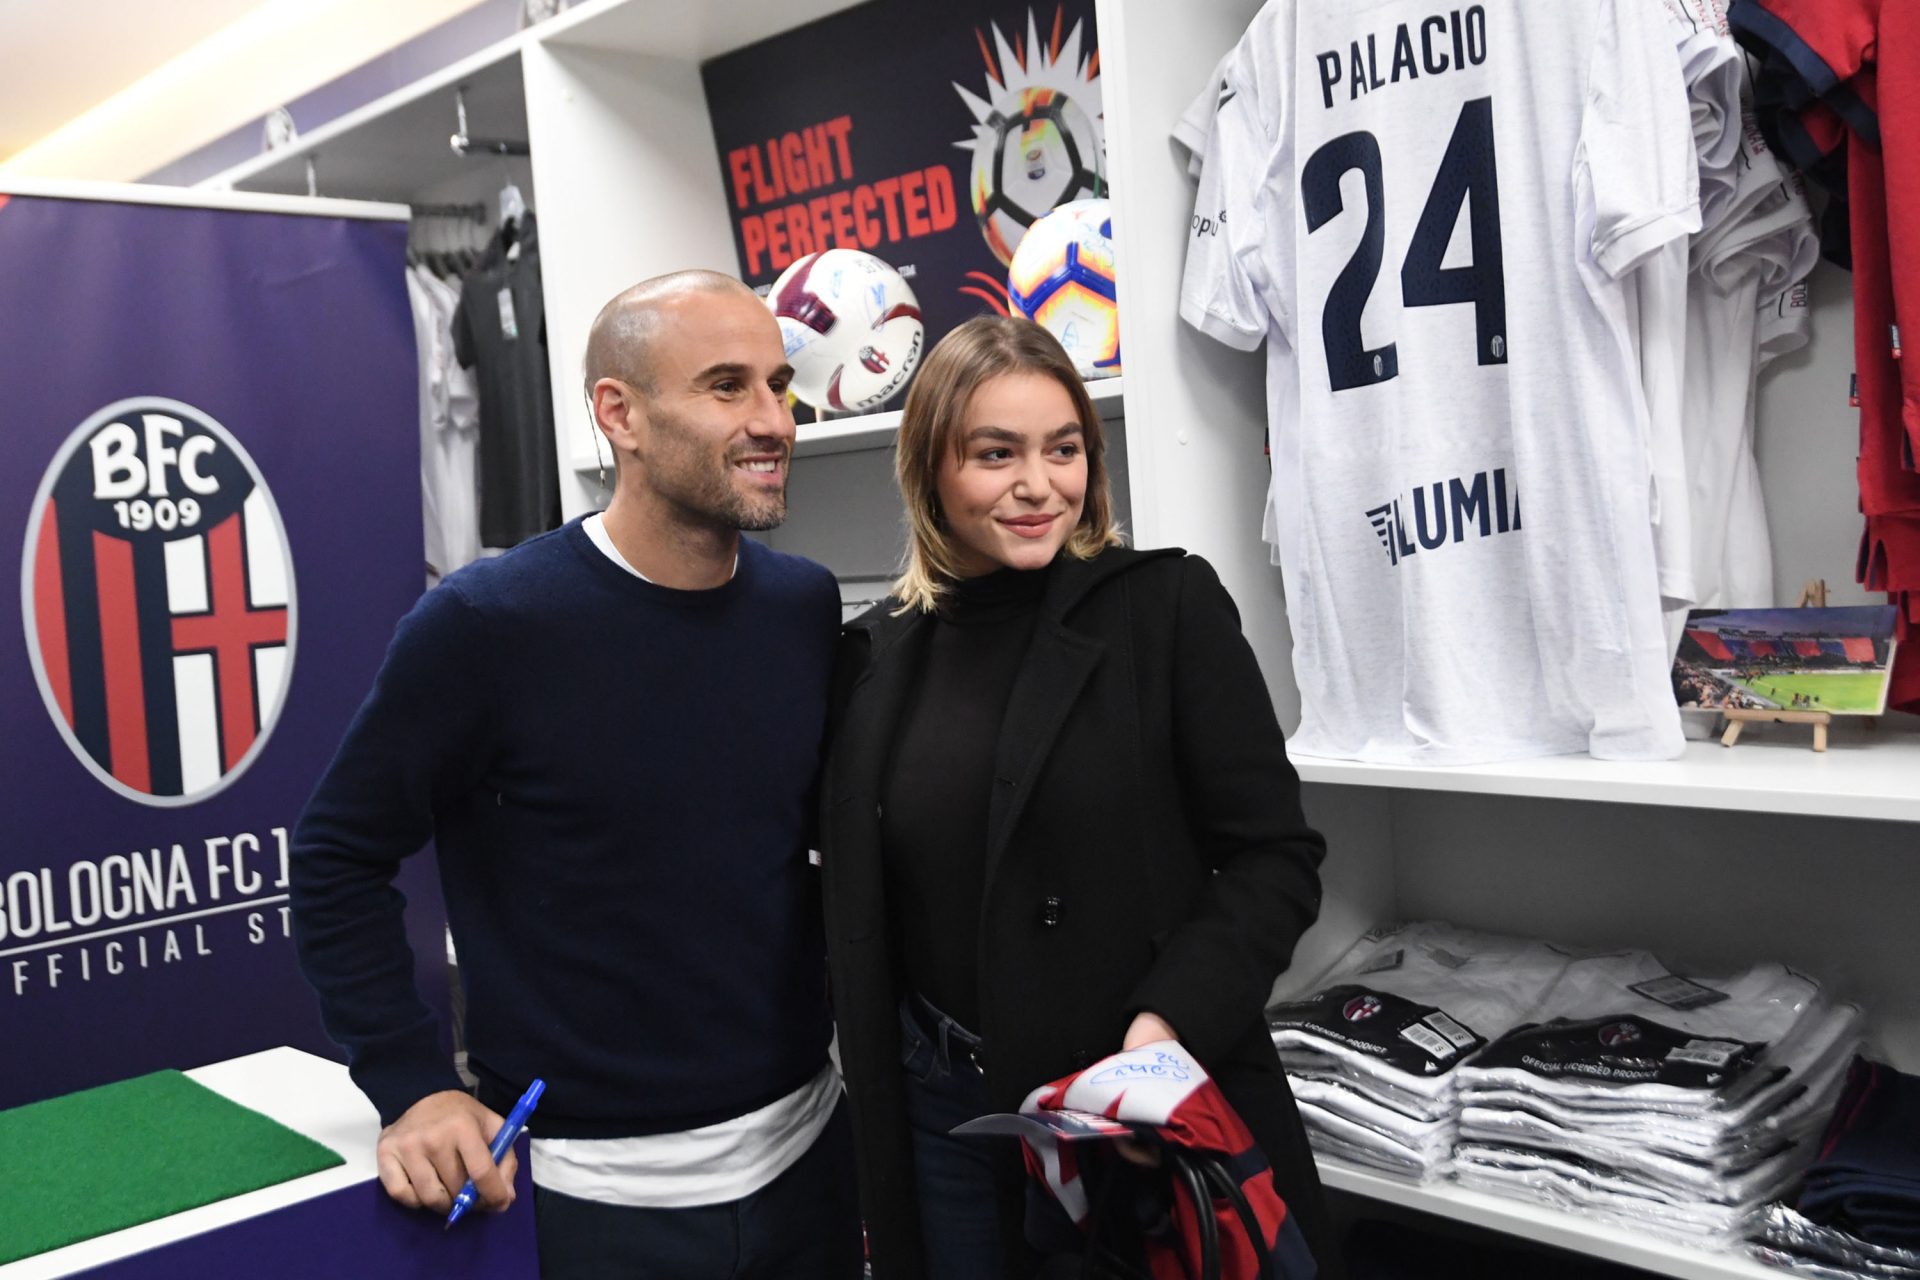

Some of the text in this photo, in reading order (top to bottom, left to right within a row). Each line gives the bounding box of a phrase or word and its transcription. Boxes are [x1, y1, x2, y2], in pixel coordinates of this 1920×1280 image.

[1316, 4, 1487, 109] PALACIO
[729, 115, 853, 208] FLIGHT
[741, 165, 957, 276] PERFECTED
[1300, 95, 1509, 392] 24
[856, 329, 921, 409] macron
[88, 413, 220, 499] BFC
[113, 497, 202, 532] 1909
[204, 832, 263, 900] FC
[1521, 1054, 1561, 1071] OFFICIAL
